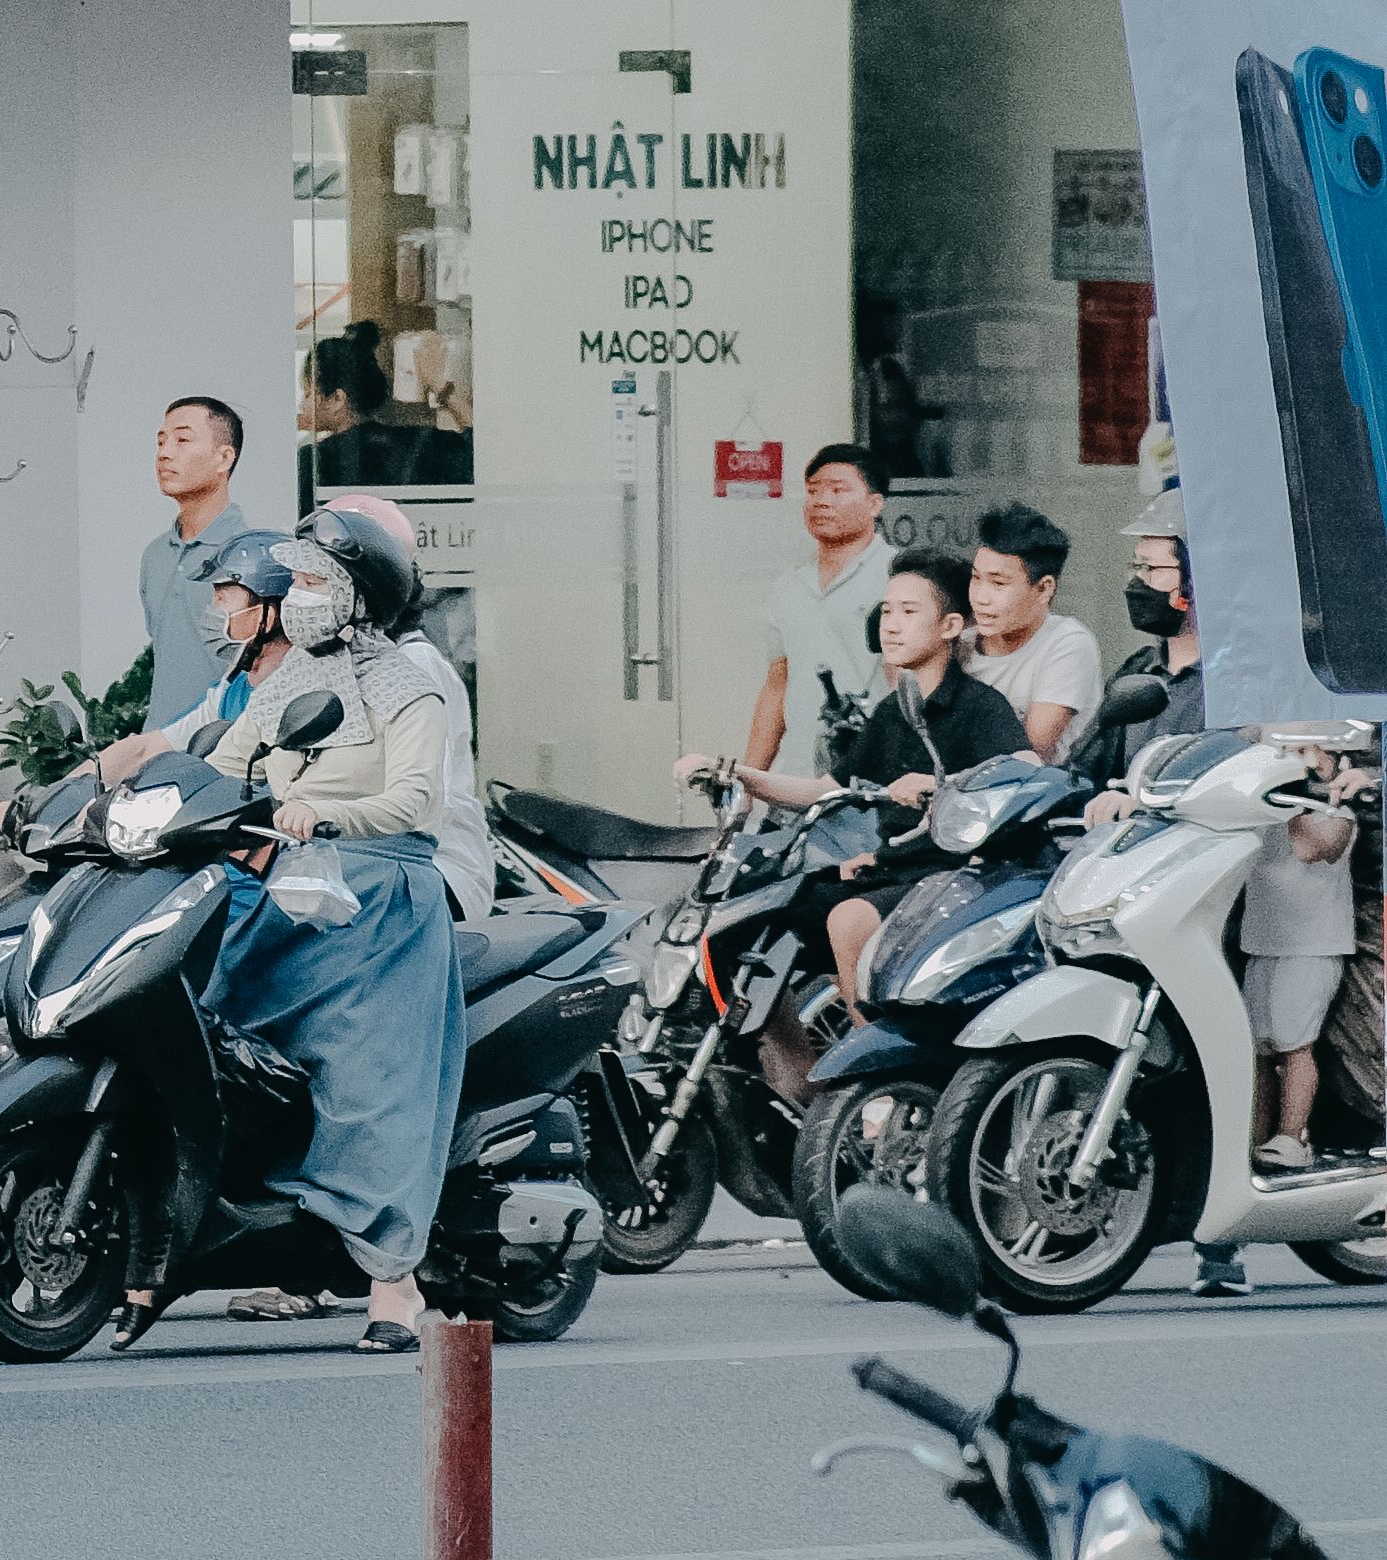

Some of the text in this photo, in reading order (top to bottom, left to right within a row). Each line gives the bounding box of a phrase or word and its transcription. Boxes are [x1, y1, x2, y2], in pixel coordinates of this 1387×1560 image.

[532, 120, 787, 199] NHẬT LINH
[600, 217, 715, 254] IPHONE
[624, 274, 694, 310] IPAD
[579, 329, 741, 365] MACBOOK
